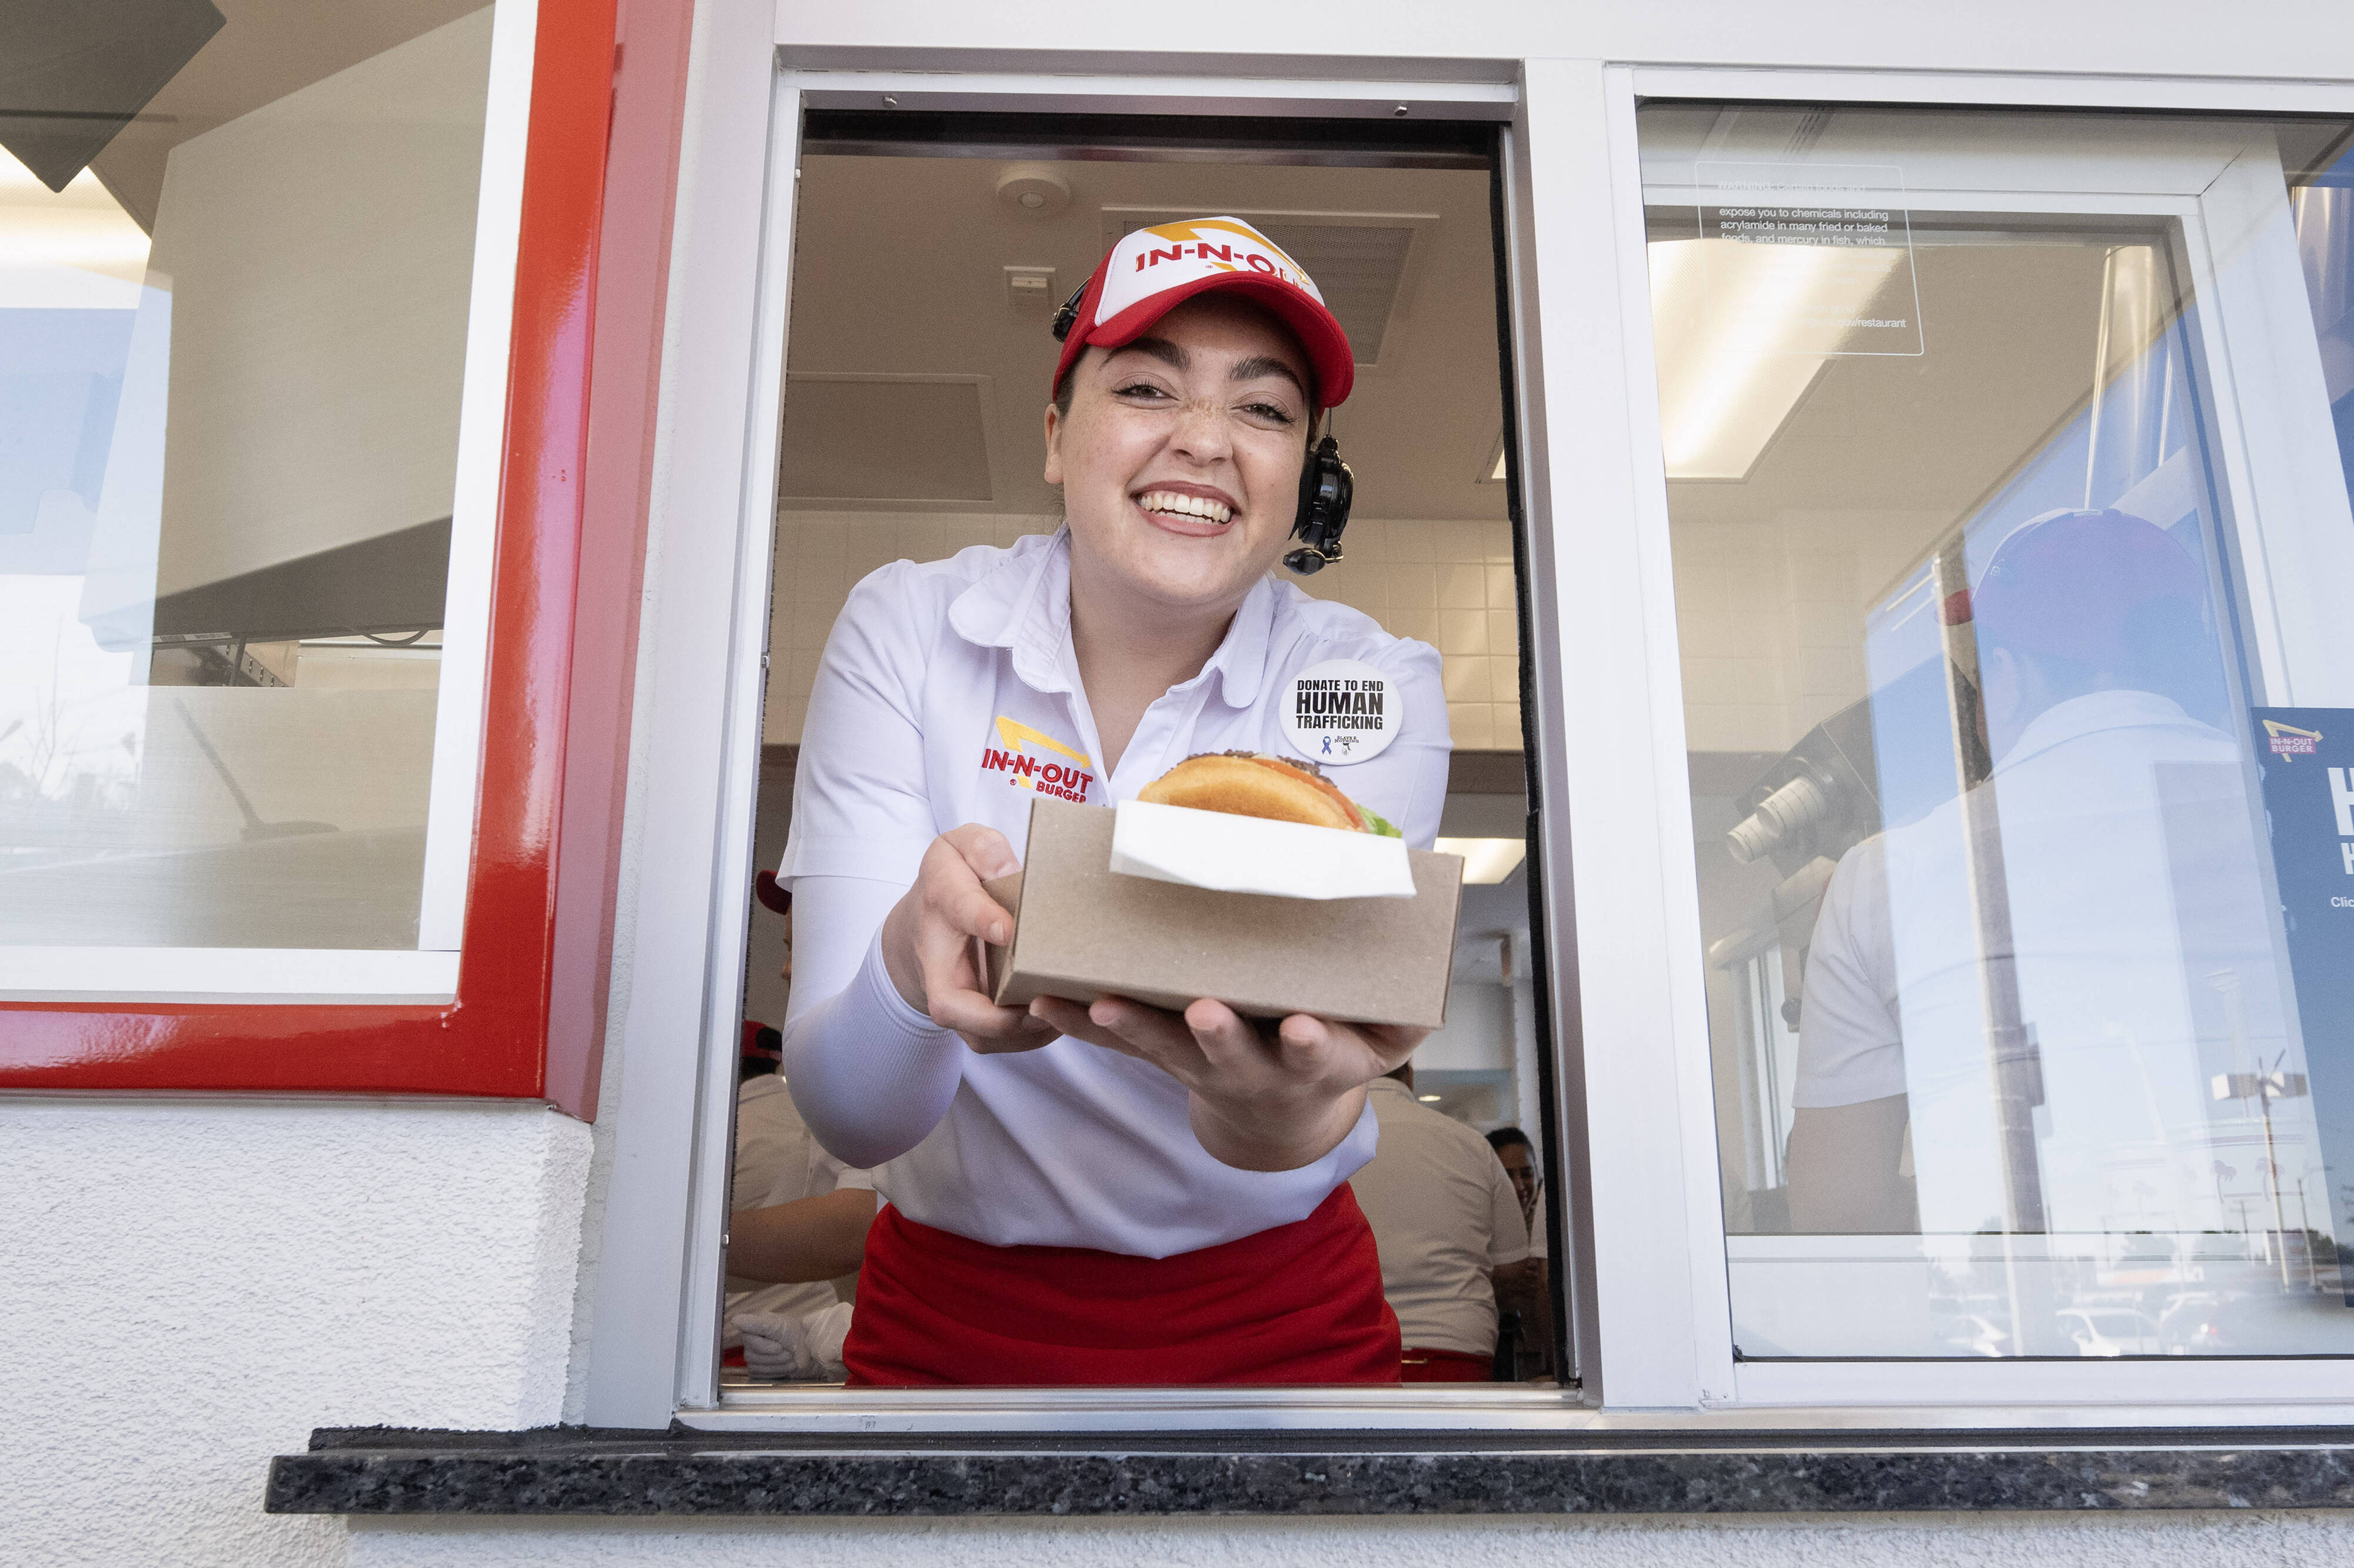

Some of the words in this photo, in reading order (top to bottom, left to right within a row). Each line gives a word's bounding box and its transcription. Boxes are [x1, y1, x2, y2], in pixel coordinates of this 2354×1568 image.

[1719, 208, 1755, 218] expose
[1758, 209, 1777, 219] you
[1779, 208, 1789, 217] to
[1791, 208, 1841, 218] chemicals
[1844, 209, 1888, 222] including
[1720, 219, 1775, 231] acrylamide
[1777, 221, 1787, 230] in
[1789, 222, 1817, 233] many
[1818, 221, 1841, 231] fried
[1844, 224, 1854, 232] or
[1856, 222, 1887, 232] baked
[1755, 234, 1774, 243] and
[1777, 235, 1818, 245] mercury
[1821, 235, 1830, 244] in
[1833, 235, 1854, 246] fish,
[1856, 236, 1886, 245] which
[1136, 243, 1304, 291] IN-N-O
[1297, 680, 1341, 691] DONATE
[1344, 680, 1358, 691] TO
[1362, 680, 1384, 691] END
[1296, 692, 1384, 715] HUMAN
[1296, 715, 1383, 730] TRAFFICKING
[982, 748, 1093, 794] IN-N-OUT
[1036, 781, 1087, 803] BURGER
